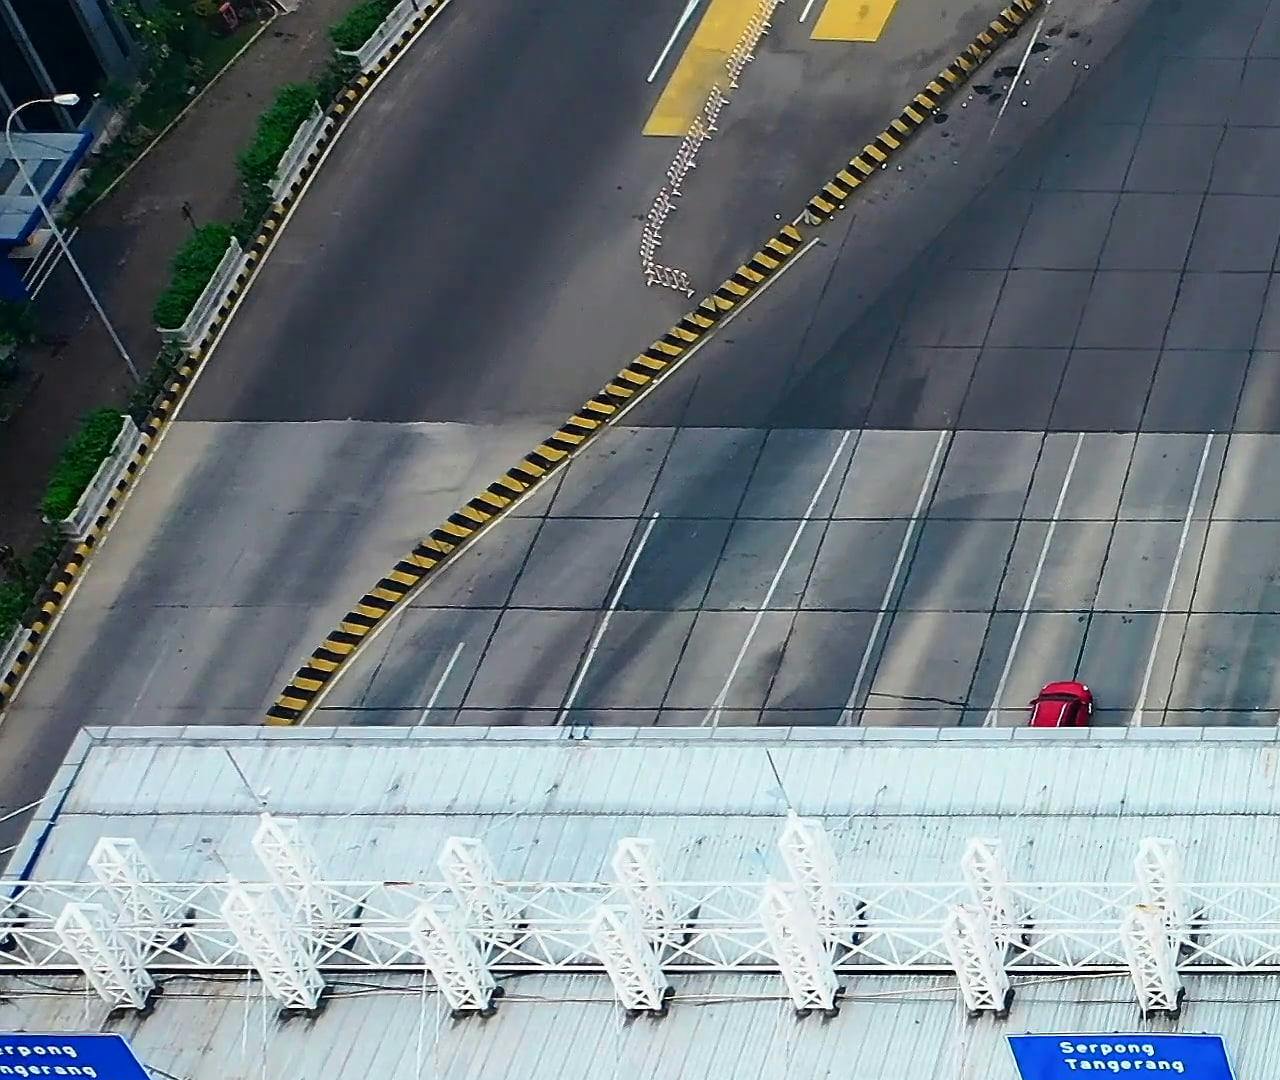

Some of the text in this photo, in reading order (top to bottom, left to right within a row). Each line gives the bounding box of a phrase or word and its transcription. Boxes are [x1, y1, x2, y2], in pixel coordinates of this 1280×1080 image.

[0, 1046, 78, 1058] rpong
[1059, 1041, 1155, 1056] Serpong
[0, 1065, 98, 1078] ngerang
[1064, 1058, 1185, 1073] Tangerang
